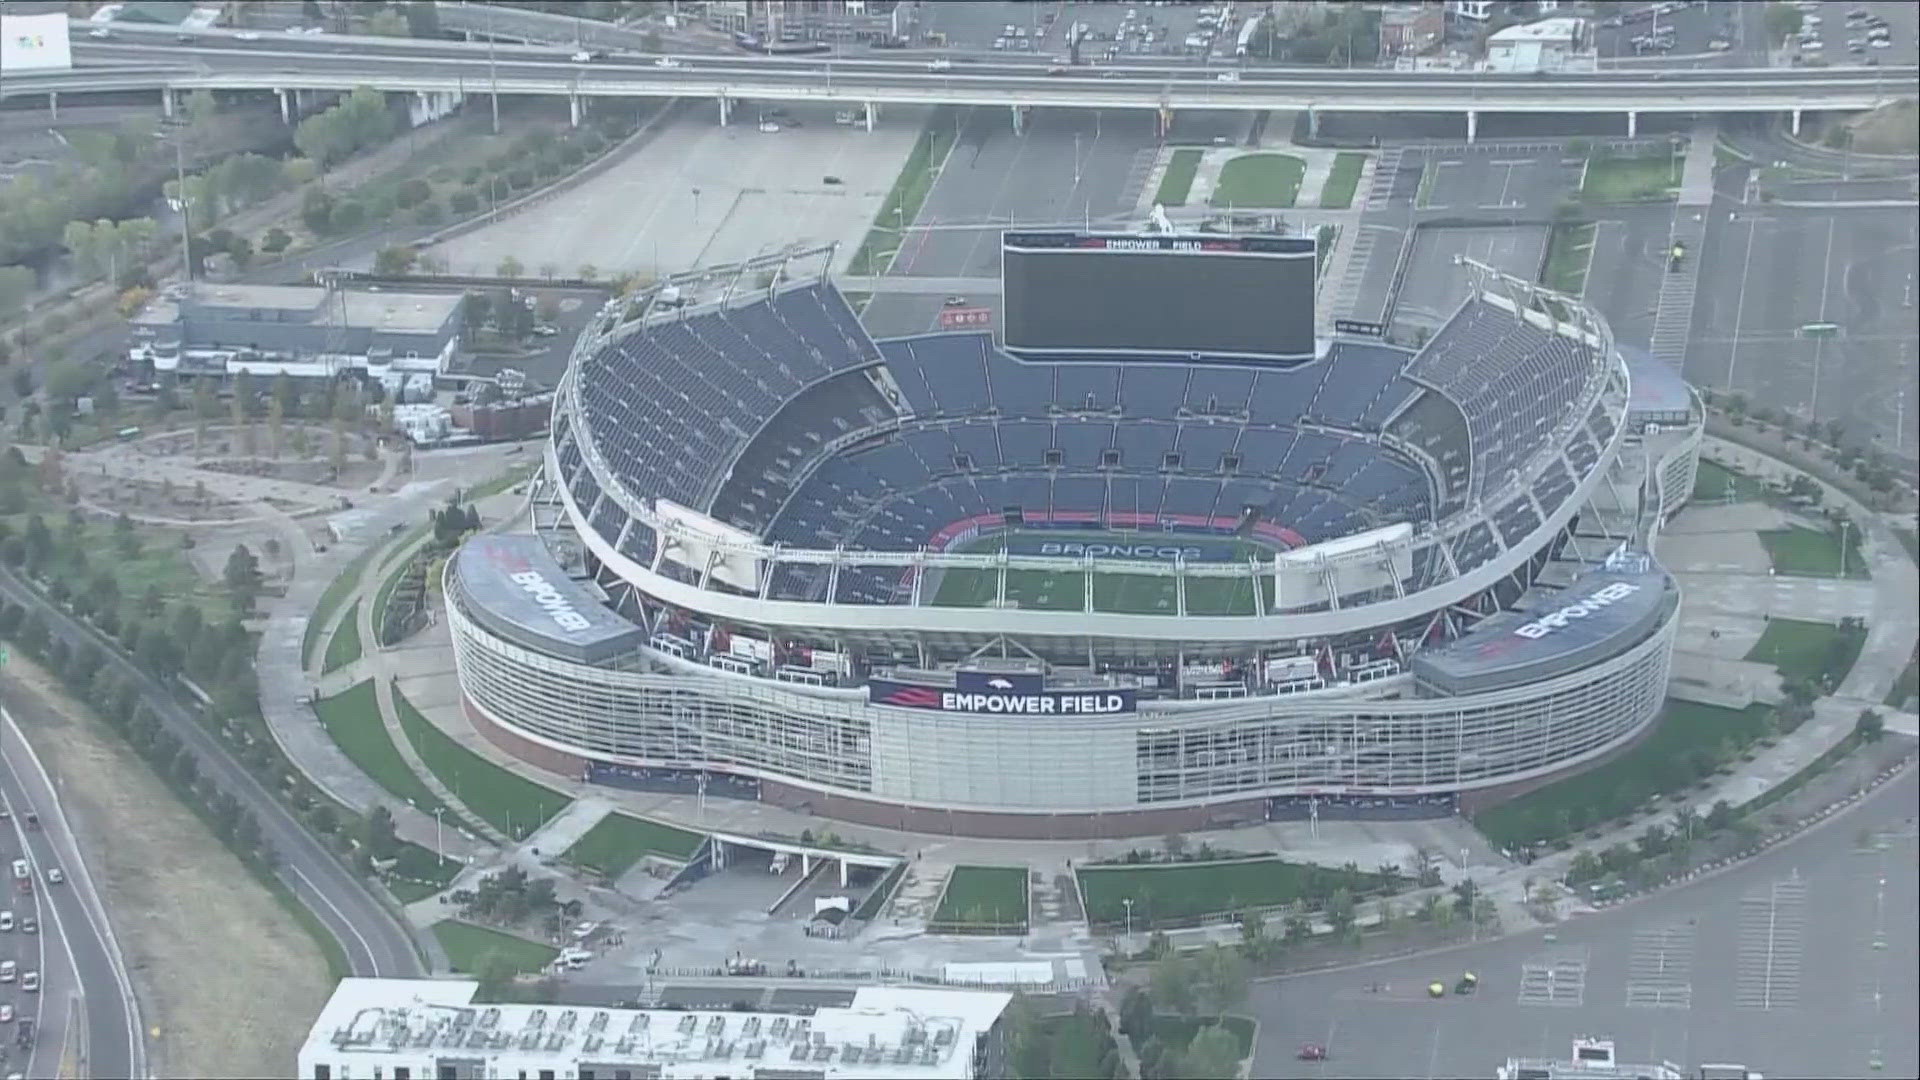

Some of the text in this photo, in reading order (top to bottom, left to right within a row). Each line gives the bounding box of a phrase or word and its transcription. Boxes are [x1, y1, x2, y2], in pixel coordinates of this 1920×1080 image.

[1106, 239, 1201, 250] EMPOWER FIELD
[1041, 543, 1201, 559] BRONCOS
[510, 571, 591, 632] EMPOWER
[1513, 582, 1640, 639] EMPOWER
[942, 693, 1123, 713] EMPOWER FIELD
